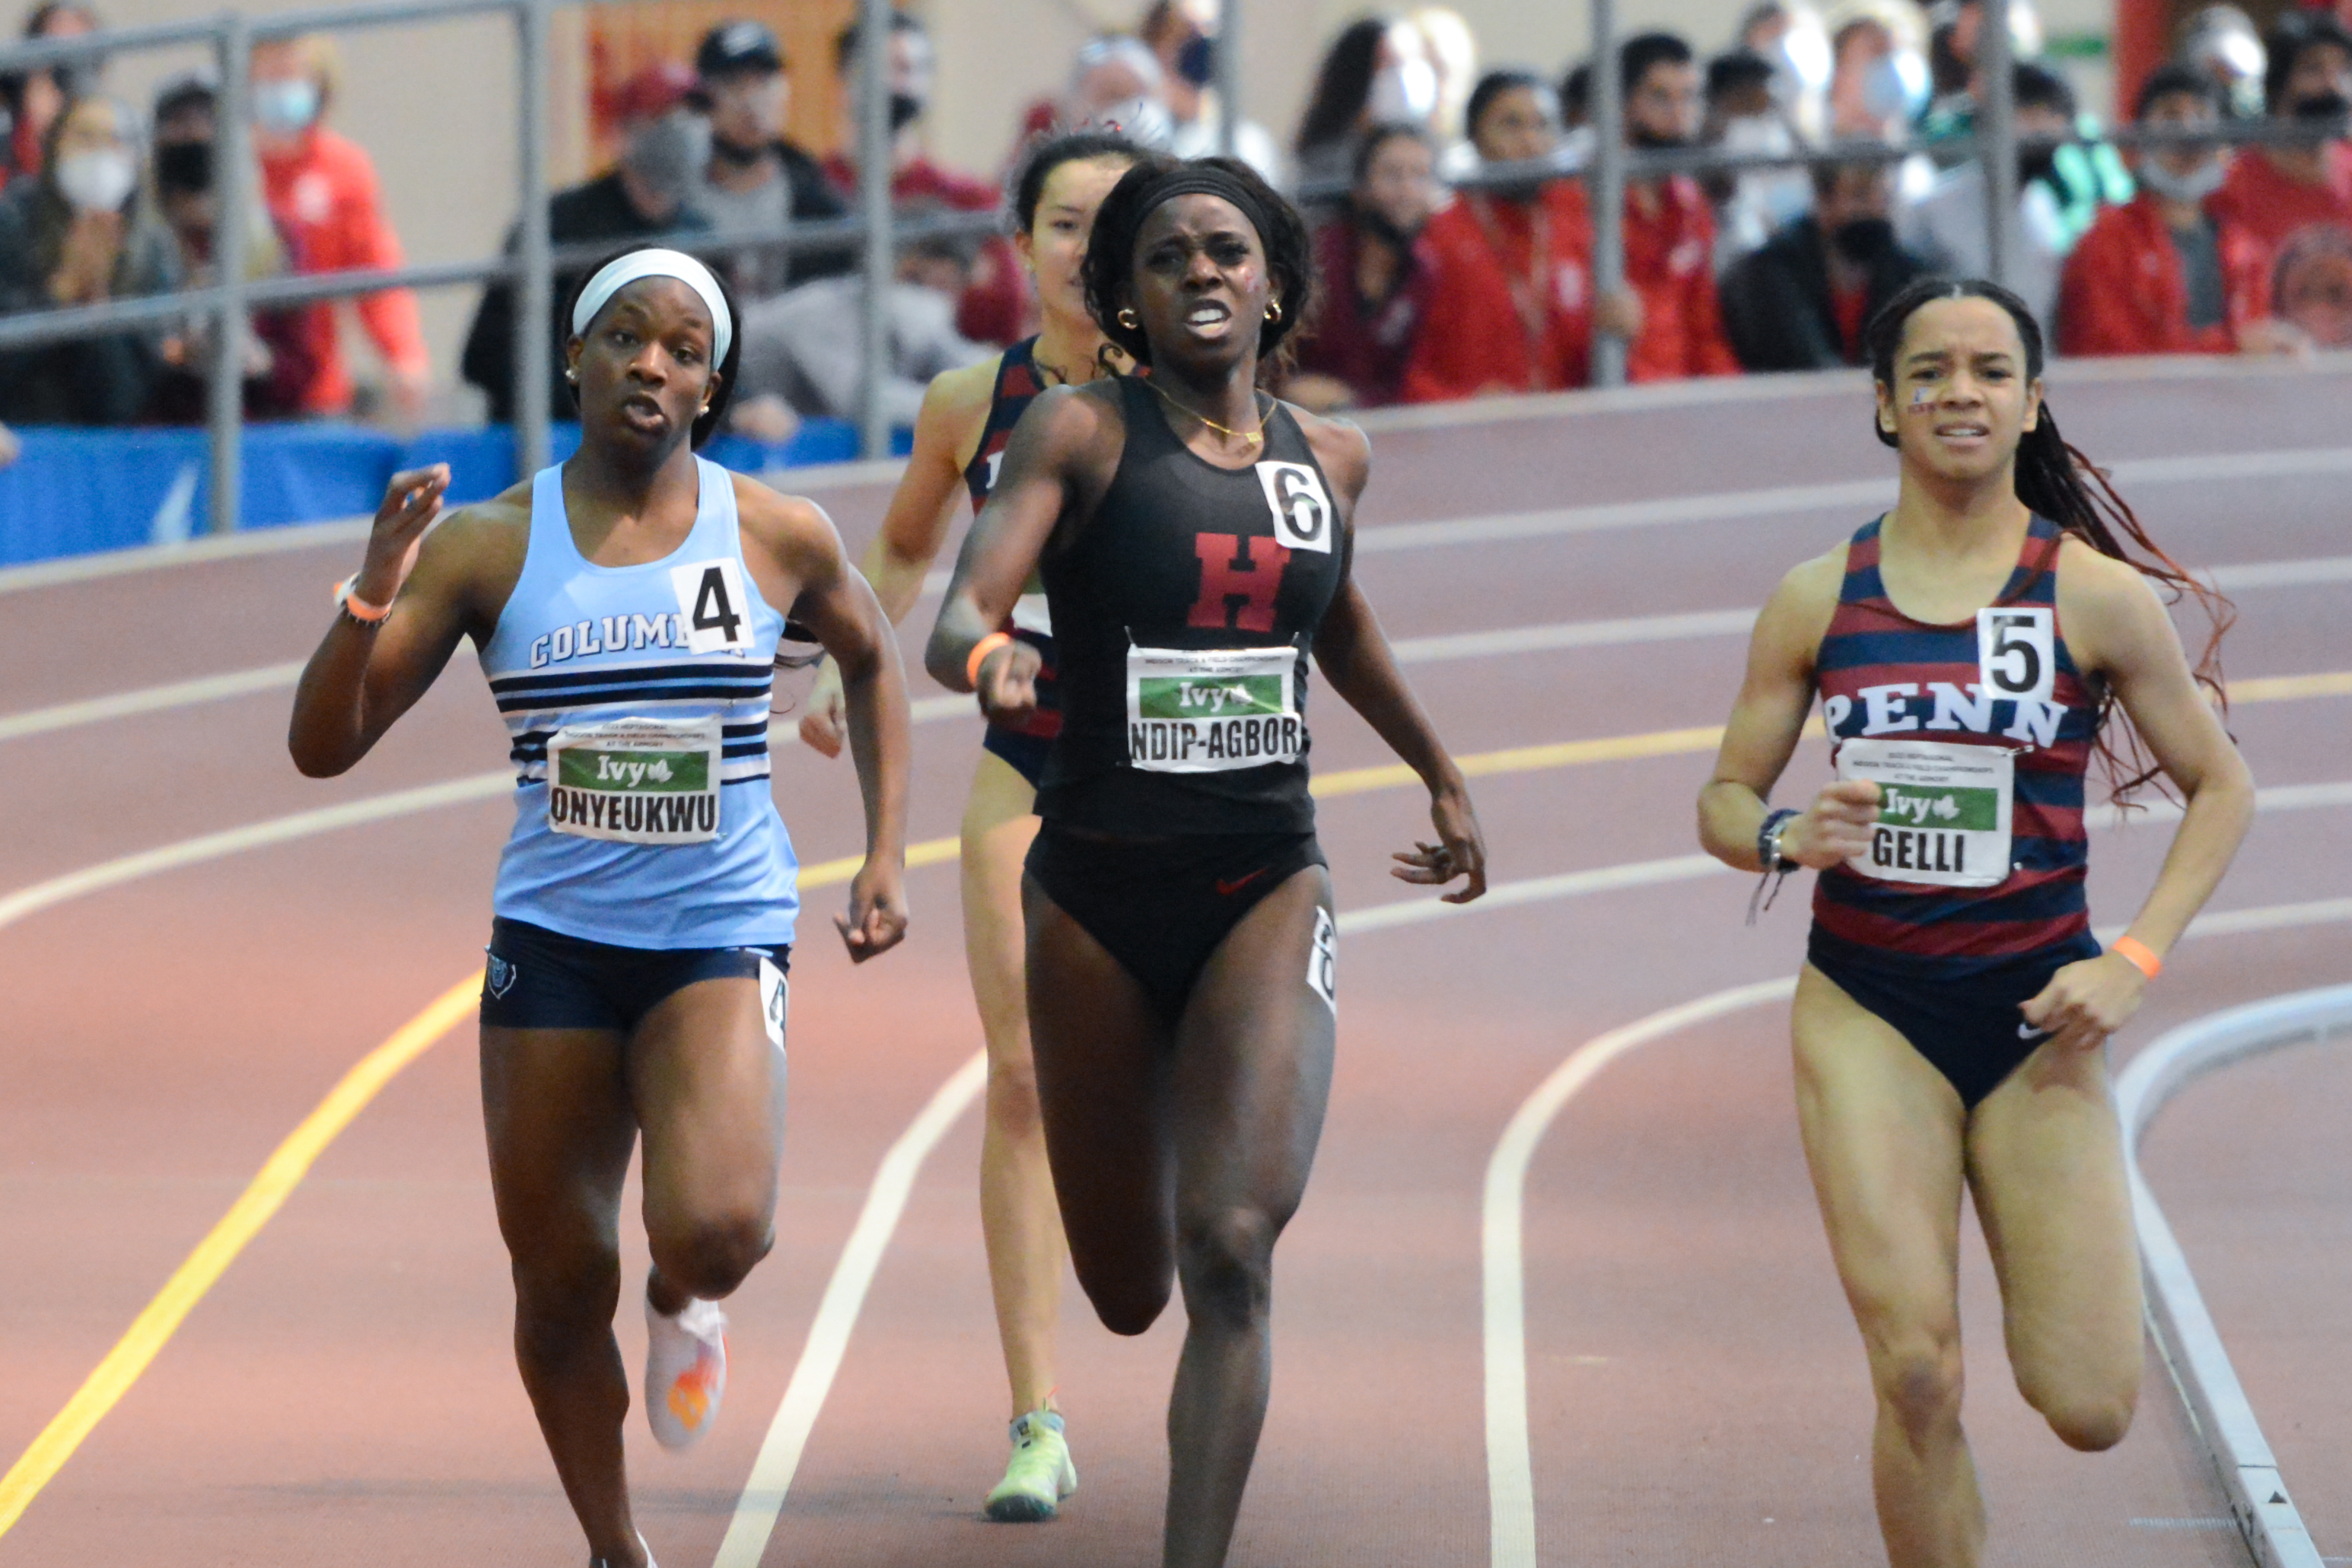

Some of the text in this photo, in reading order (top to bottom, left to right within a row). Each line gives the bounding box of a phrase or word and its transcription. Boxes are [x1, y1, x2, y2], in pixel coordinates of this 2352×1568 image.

[1273, 467, 1323, 542] 6
[692, 566, 741, 643] 4
[1186, 532, 1292, 633] H
[1991, 615, 2040, 693] 5
[1178, 681, 1230, 713] Ivy
[1825, 682, 2068, 749] PENN
[1131, 717, 1300, 761] NDIP-AGBOR
[596, 755, 648, 787] Ivy
[550, 787, 716, 833] ONYEUKWU
[1884, 788, 1933, 824] Ivy
[1873, 827, 1964, 873] GELLI
